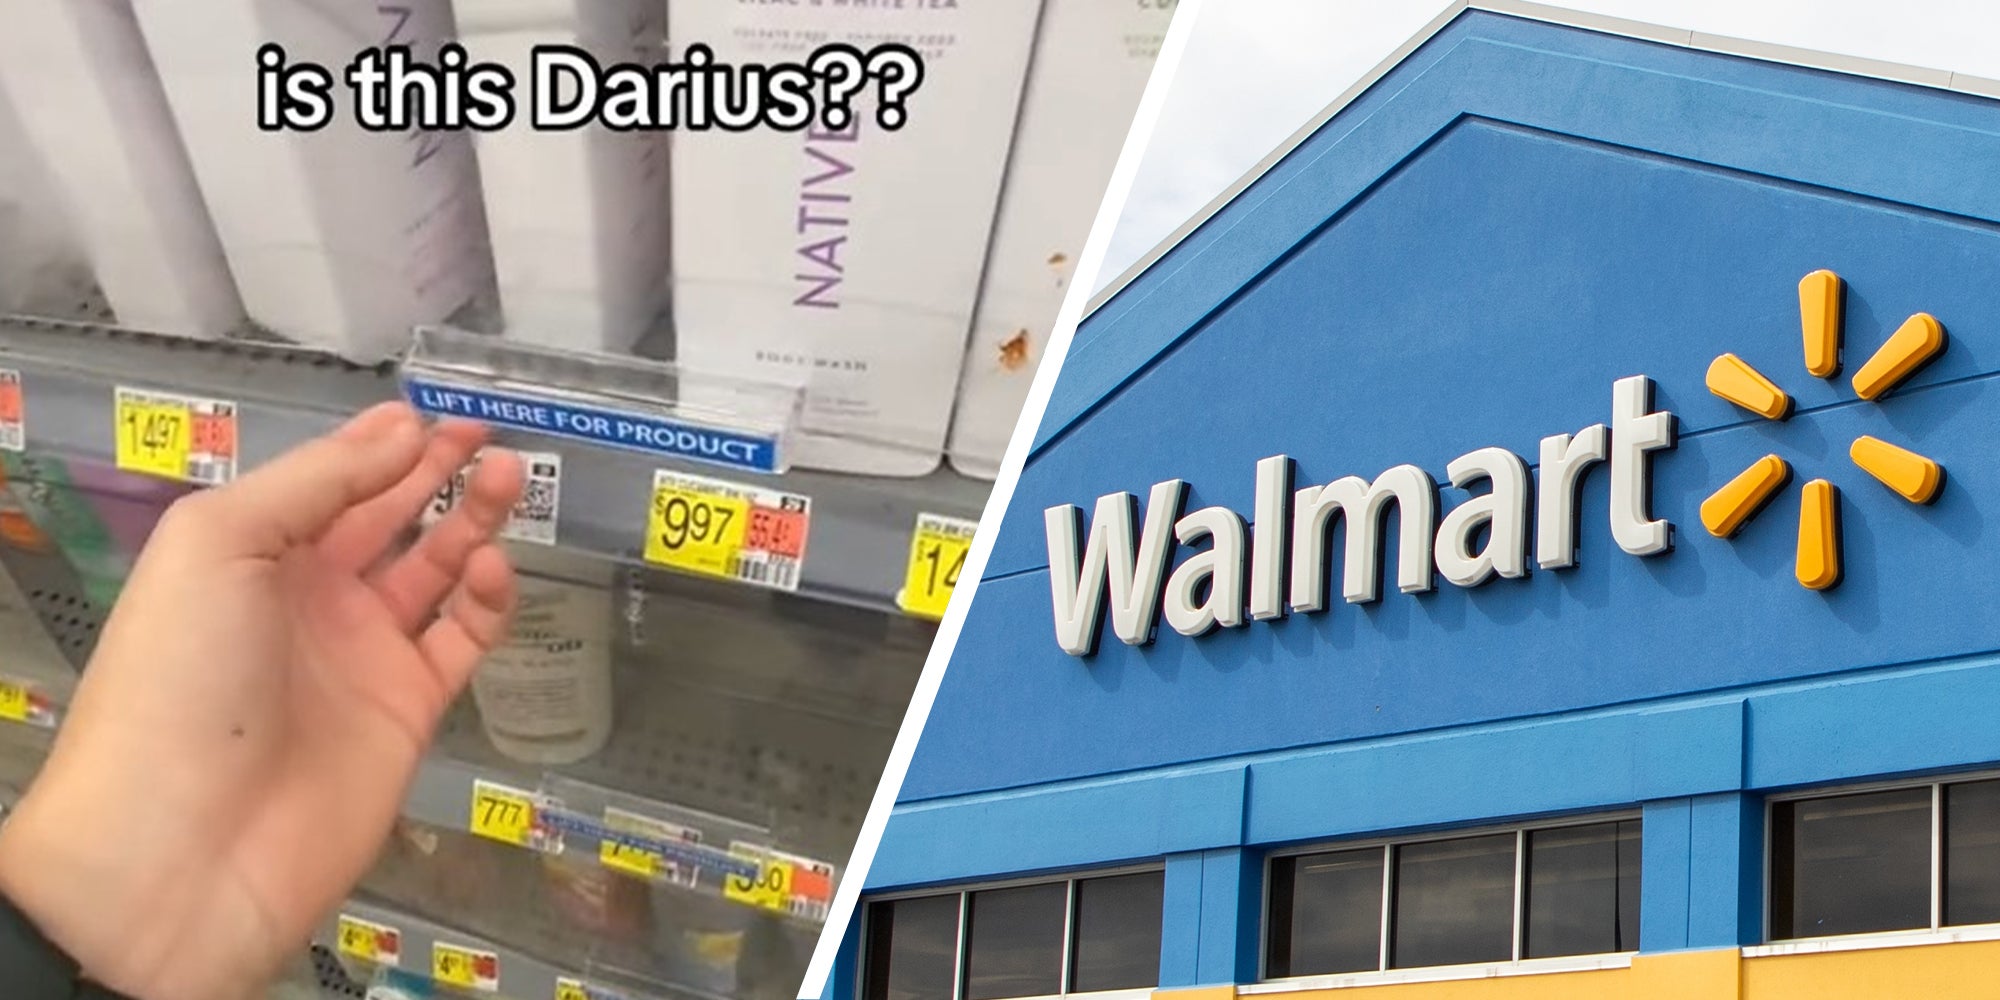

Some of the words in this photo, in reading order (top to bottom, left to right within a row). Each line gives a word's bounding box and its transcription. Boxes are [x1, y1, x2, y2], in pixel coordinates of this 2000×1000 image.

[793, 112, 860, 309] NATIVE
[421, 389, 475, 414] LIFT
[481, 396, 548, 425] HERE
[554, 411, 610, 436] FOR
[617, 421, 759, 460] PRODUCT
[1045, 376, 1677, 657] Walmart
